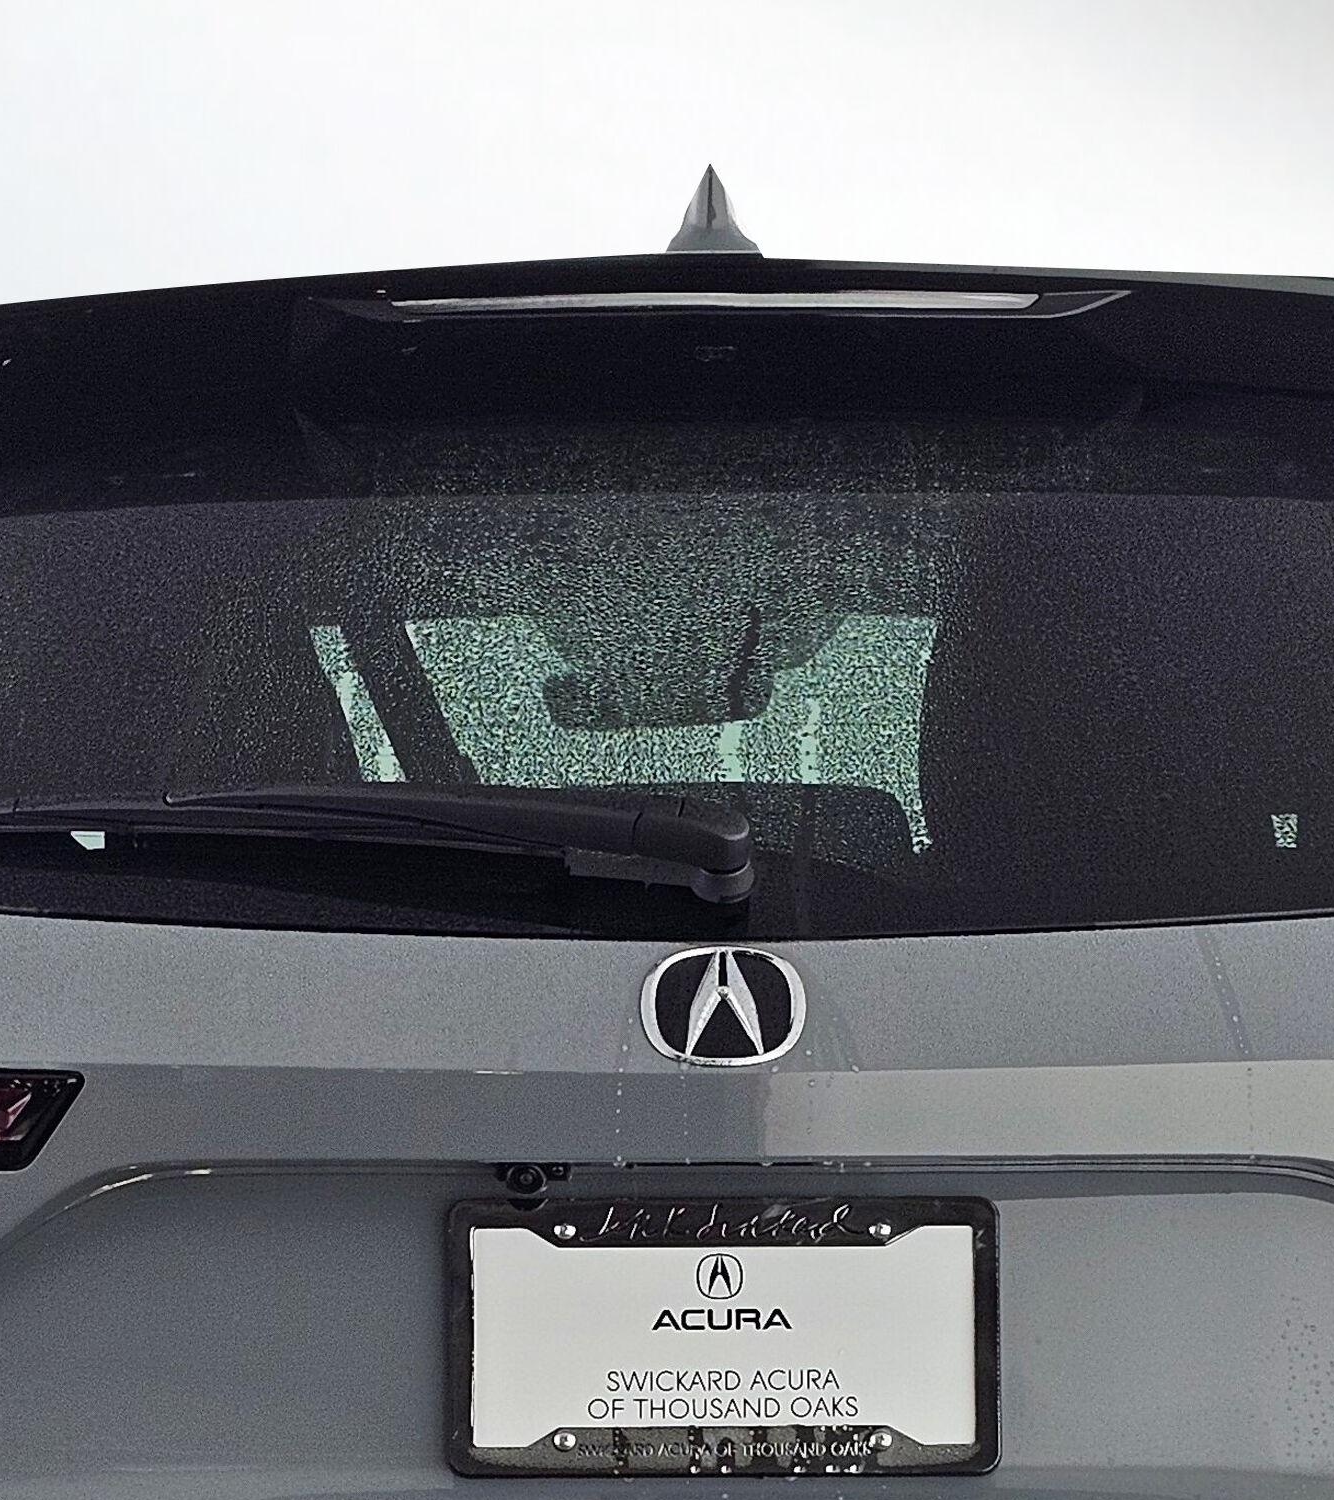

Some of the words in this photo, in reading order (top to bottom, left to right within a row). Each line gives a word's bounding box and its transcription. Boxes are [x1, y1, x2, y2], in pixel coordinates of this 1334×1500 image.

[651, 1308, 793, 1331] ACURA
[607, 1370, 741, 1392] SWICKARD
[749, 1369, 840, 1391] ACURA
[587, 1398, 625, 1420] OF
[633, 1397, 781, 1420] THOUSAND
[790, 1396, 859, 1418] OAKS
[741, 1441, 827, 1458] THOUSAND
